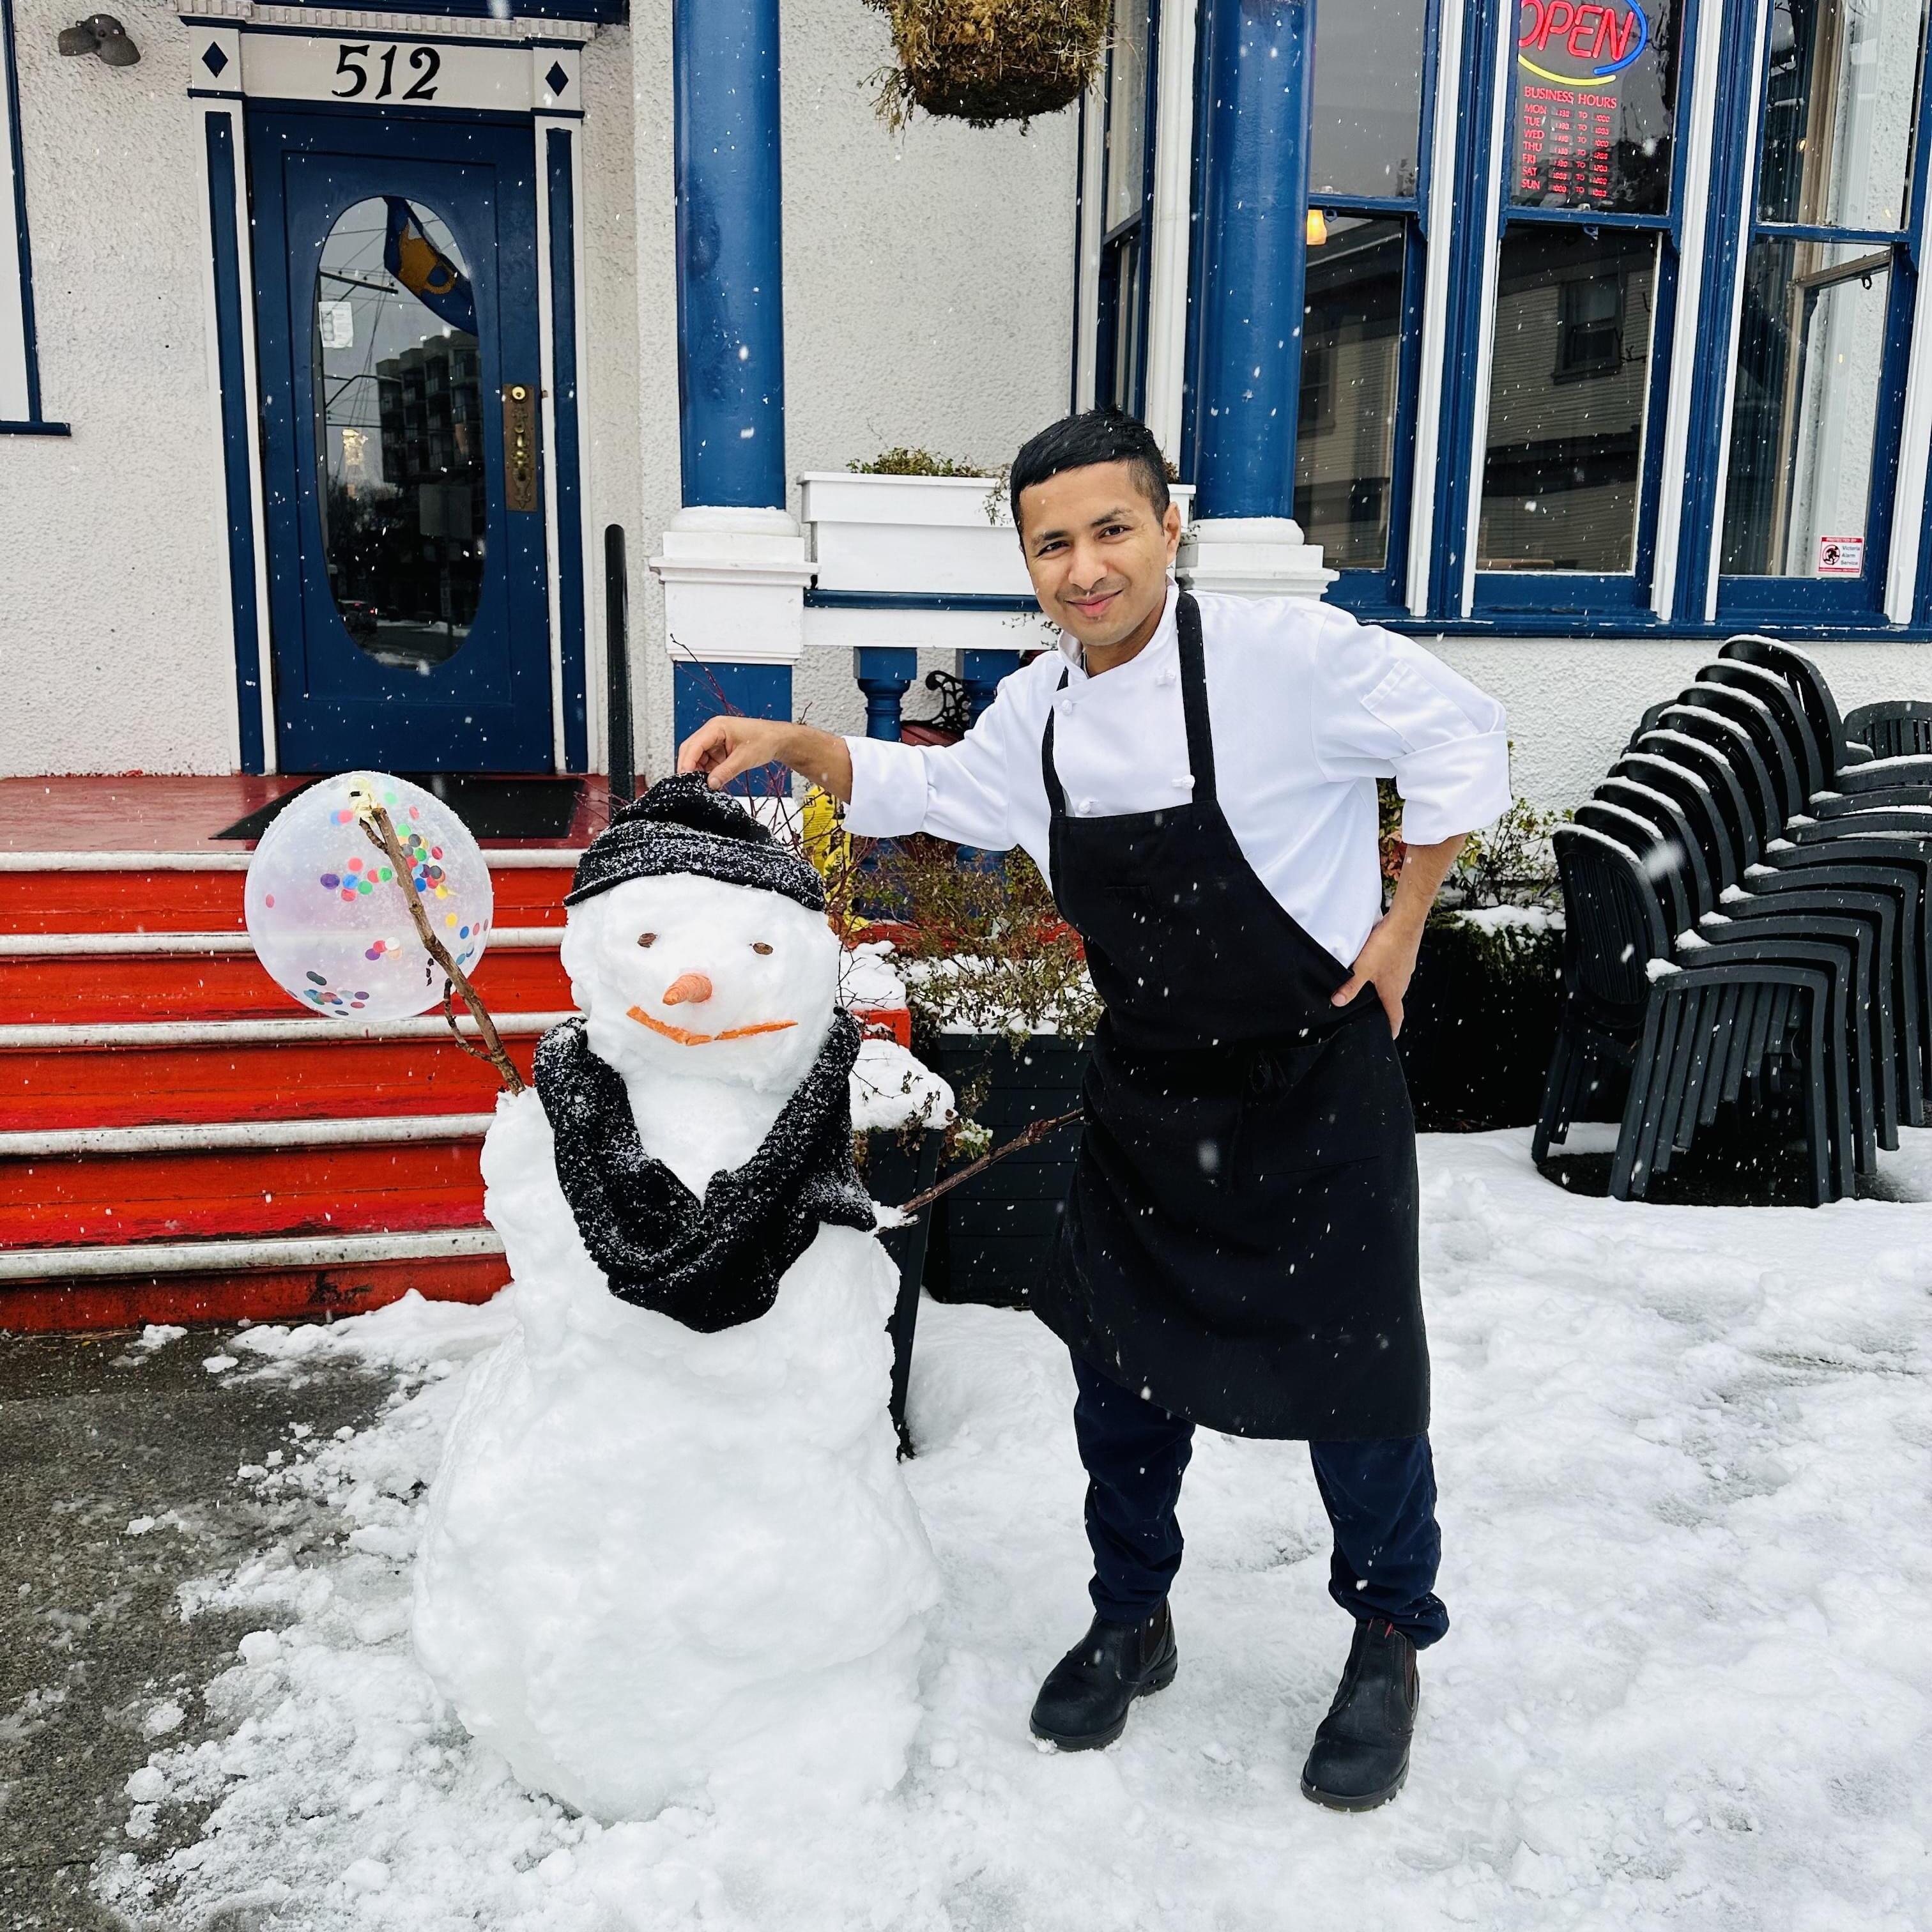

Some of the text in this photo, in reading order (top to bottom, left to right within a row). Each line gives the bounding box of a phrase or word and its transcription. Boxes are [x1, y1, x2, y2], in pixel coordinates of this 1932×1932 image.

[1518, 0, 1634, 61] OPEN
[332, 44, 440, 100] 512
[1524, 86, 1617, 109] BUSINESS HOURS
[1524, 103, 1547, 114] MON
[1524, 116, 1541, 126] TUE
[1524, 129, 1545, 140] WED
[1523, 141, 1542, 152] THU
[1522, 153, 1537, 164] FRI
[1576, 160, 1586, 169] TO
[1522, 166, 1538, 176] SAT
[1521, 179, 1540, 190] SUN
